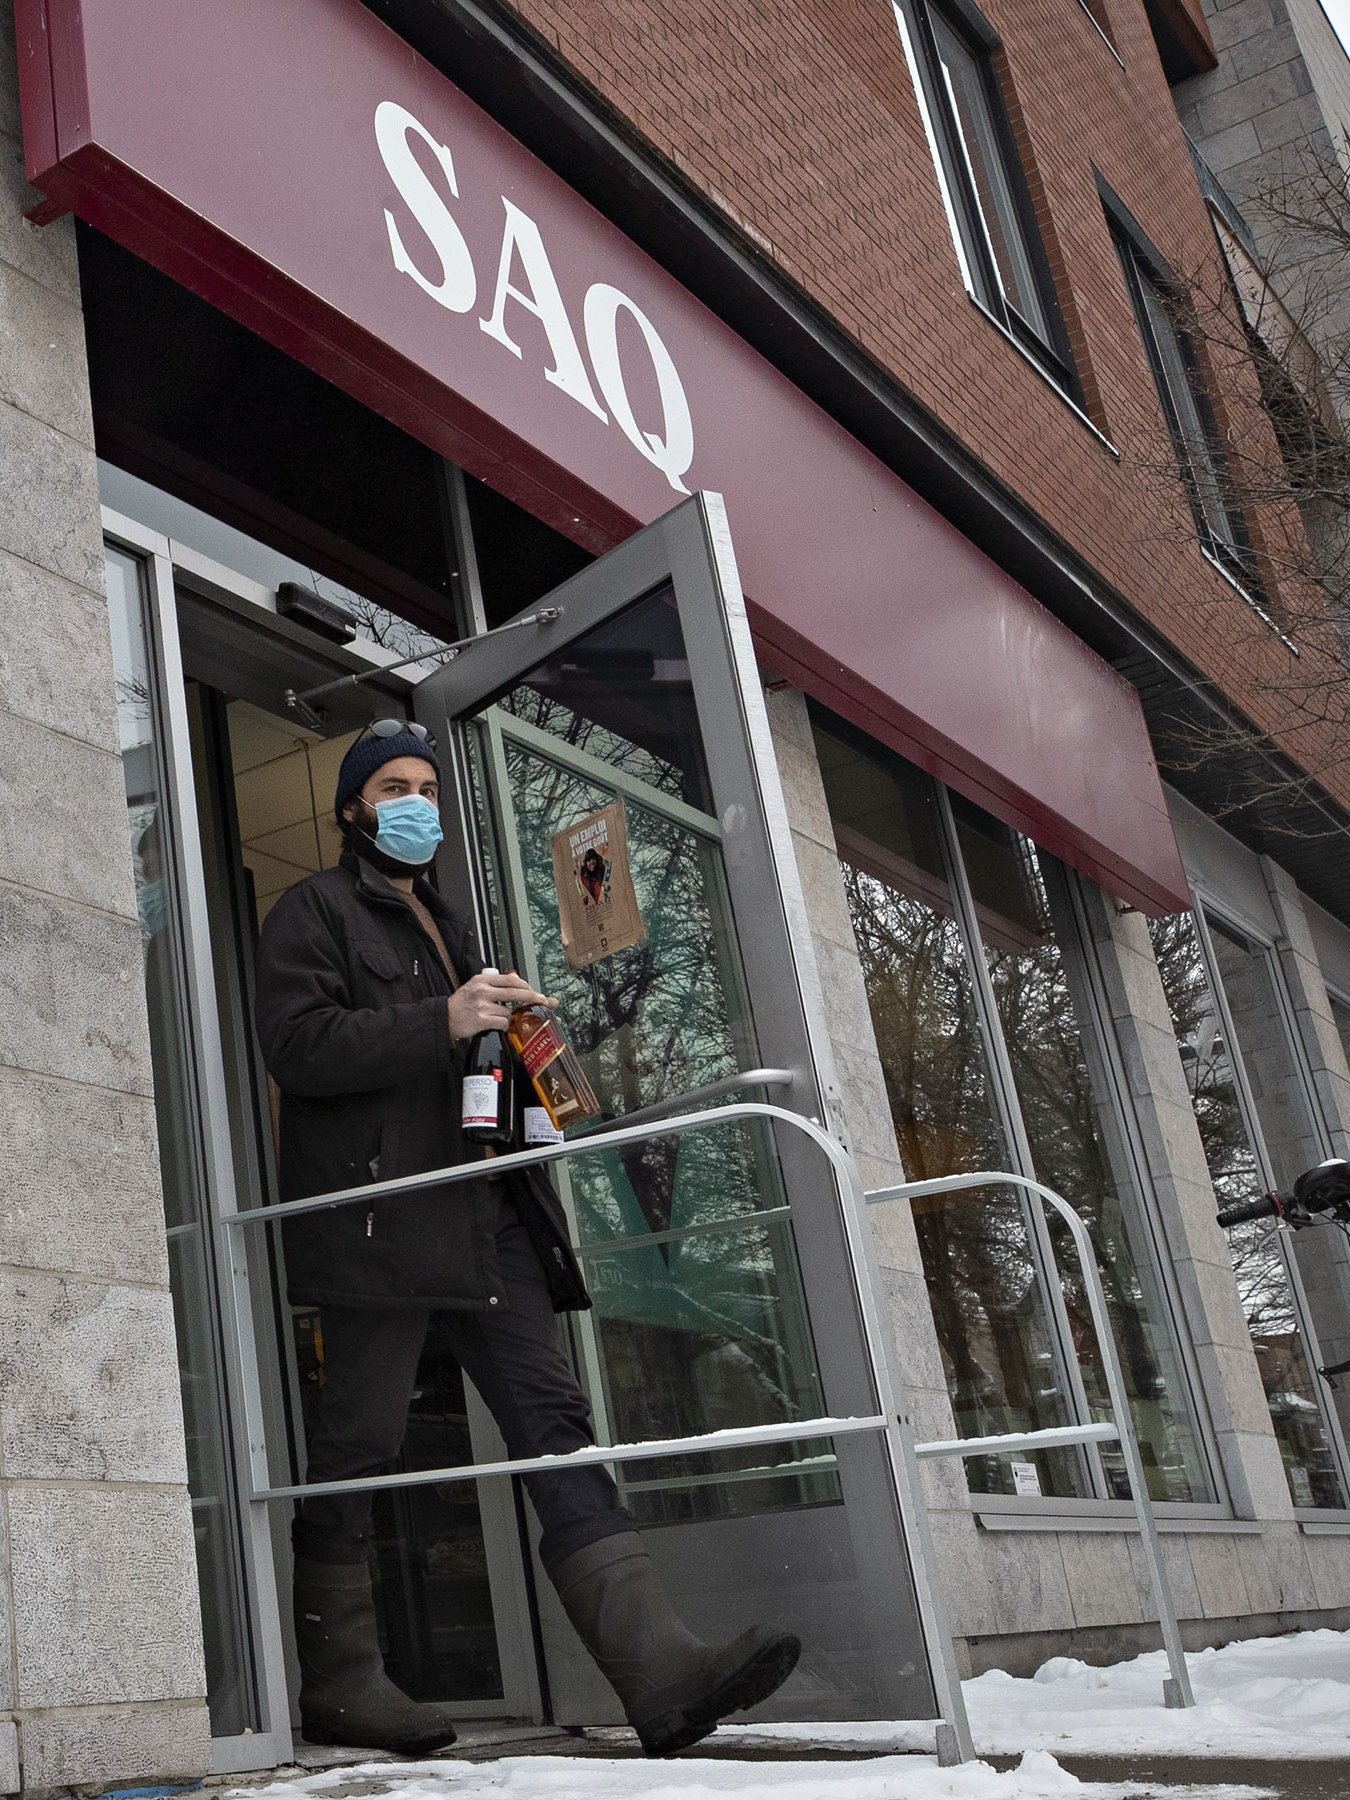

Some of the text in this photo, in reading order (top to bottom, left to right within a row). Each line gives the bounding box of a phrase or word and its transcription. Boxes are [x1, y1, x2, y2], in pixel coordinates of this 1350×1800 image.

[375, 101, 694, 496] SAQ
[569, 819, 607, 848] UN EMPLOI
